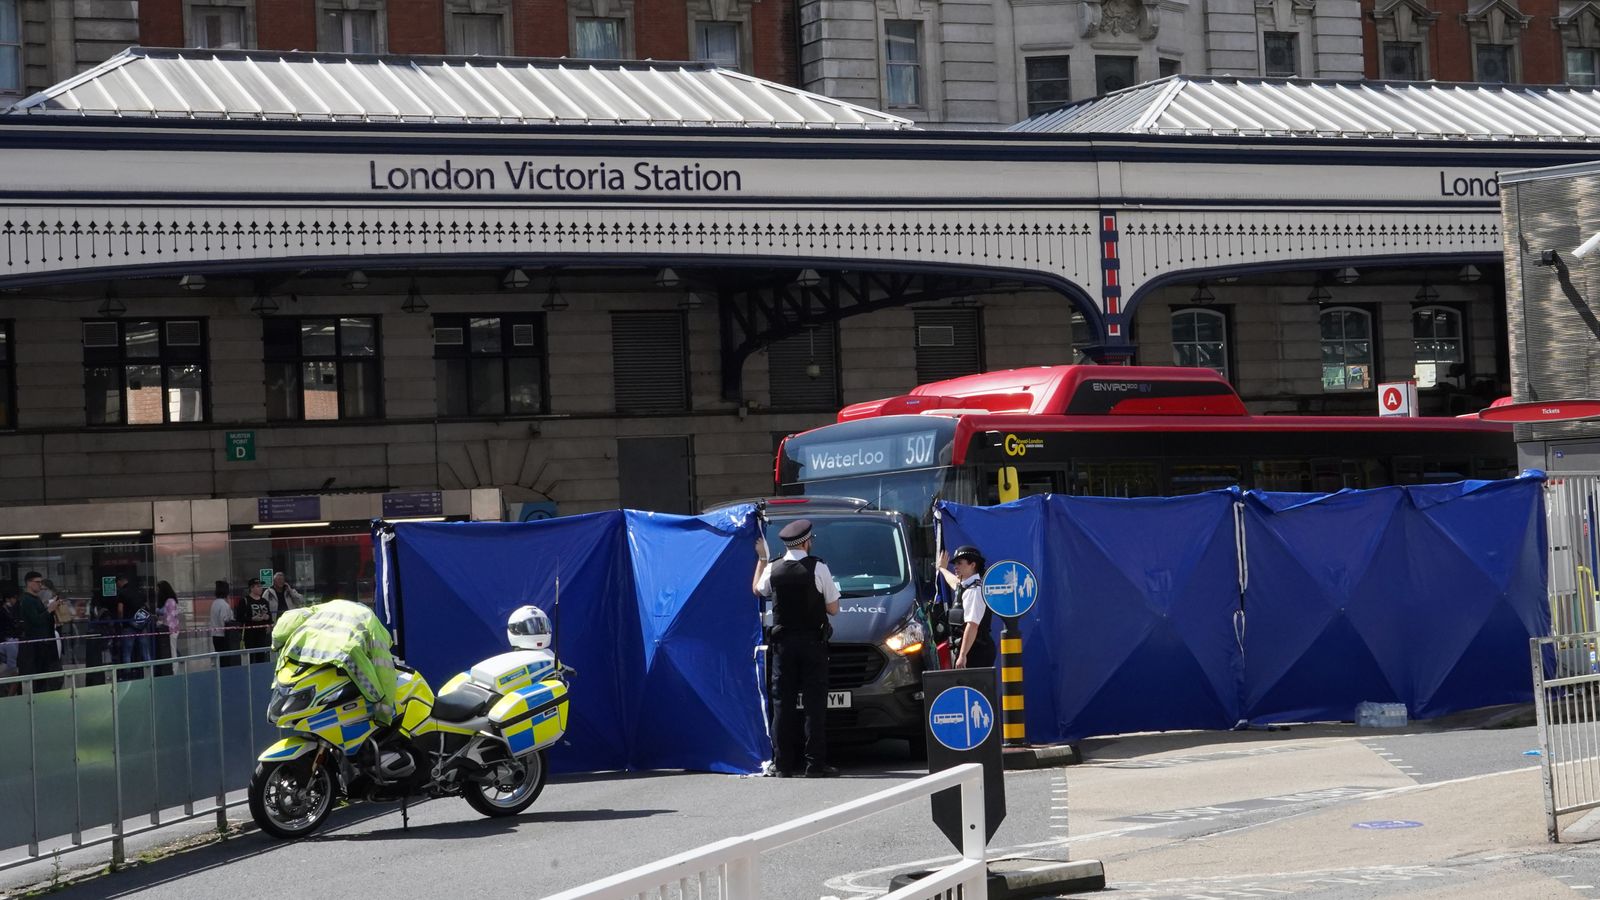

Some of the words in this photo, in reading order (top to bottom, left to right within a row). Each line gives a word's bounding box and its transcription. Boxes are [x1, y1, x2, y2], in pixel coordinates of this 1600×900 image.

[370, 160, 495, 190] London
[504, 161, 625, 190] Victoria
[633, 162, 742, 191] Station
[1440, 171, 1499, 196] Lond
[1387, 391, 1398, 406] A
[235, 446, 246, 458] D
[905, 434, 936, 465] 507
[1004, 433, 1026, 456] Go
[811, 448, 884, 470] Waterloo
